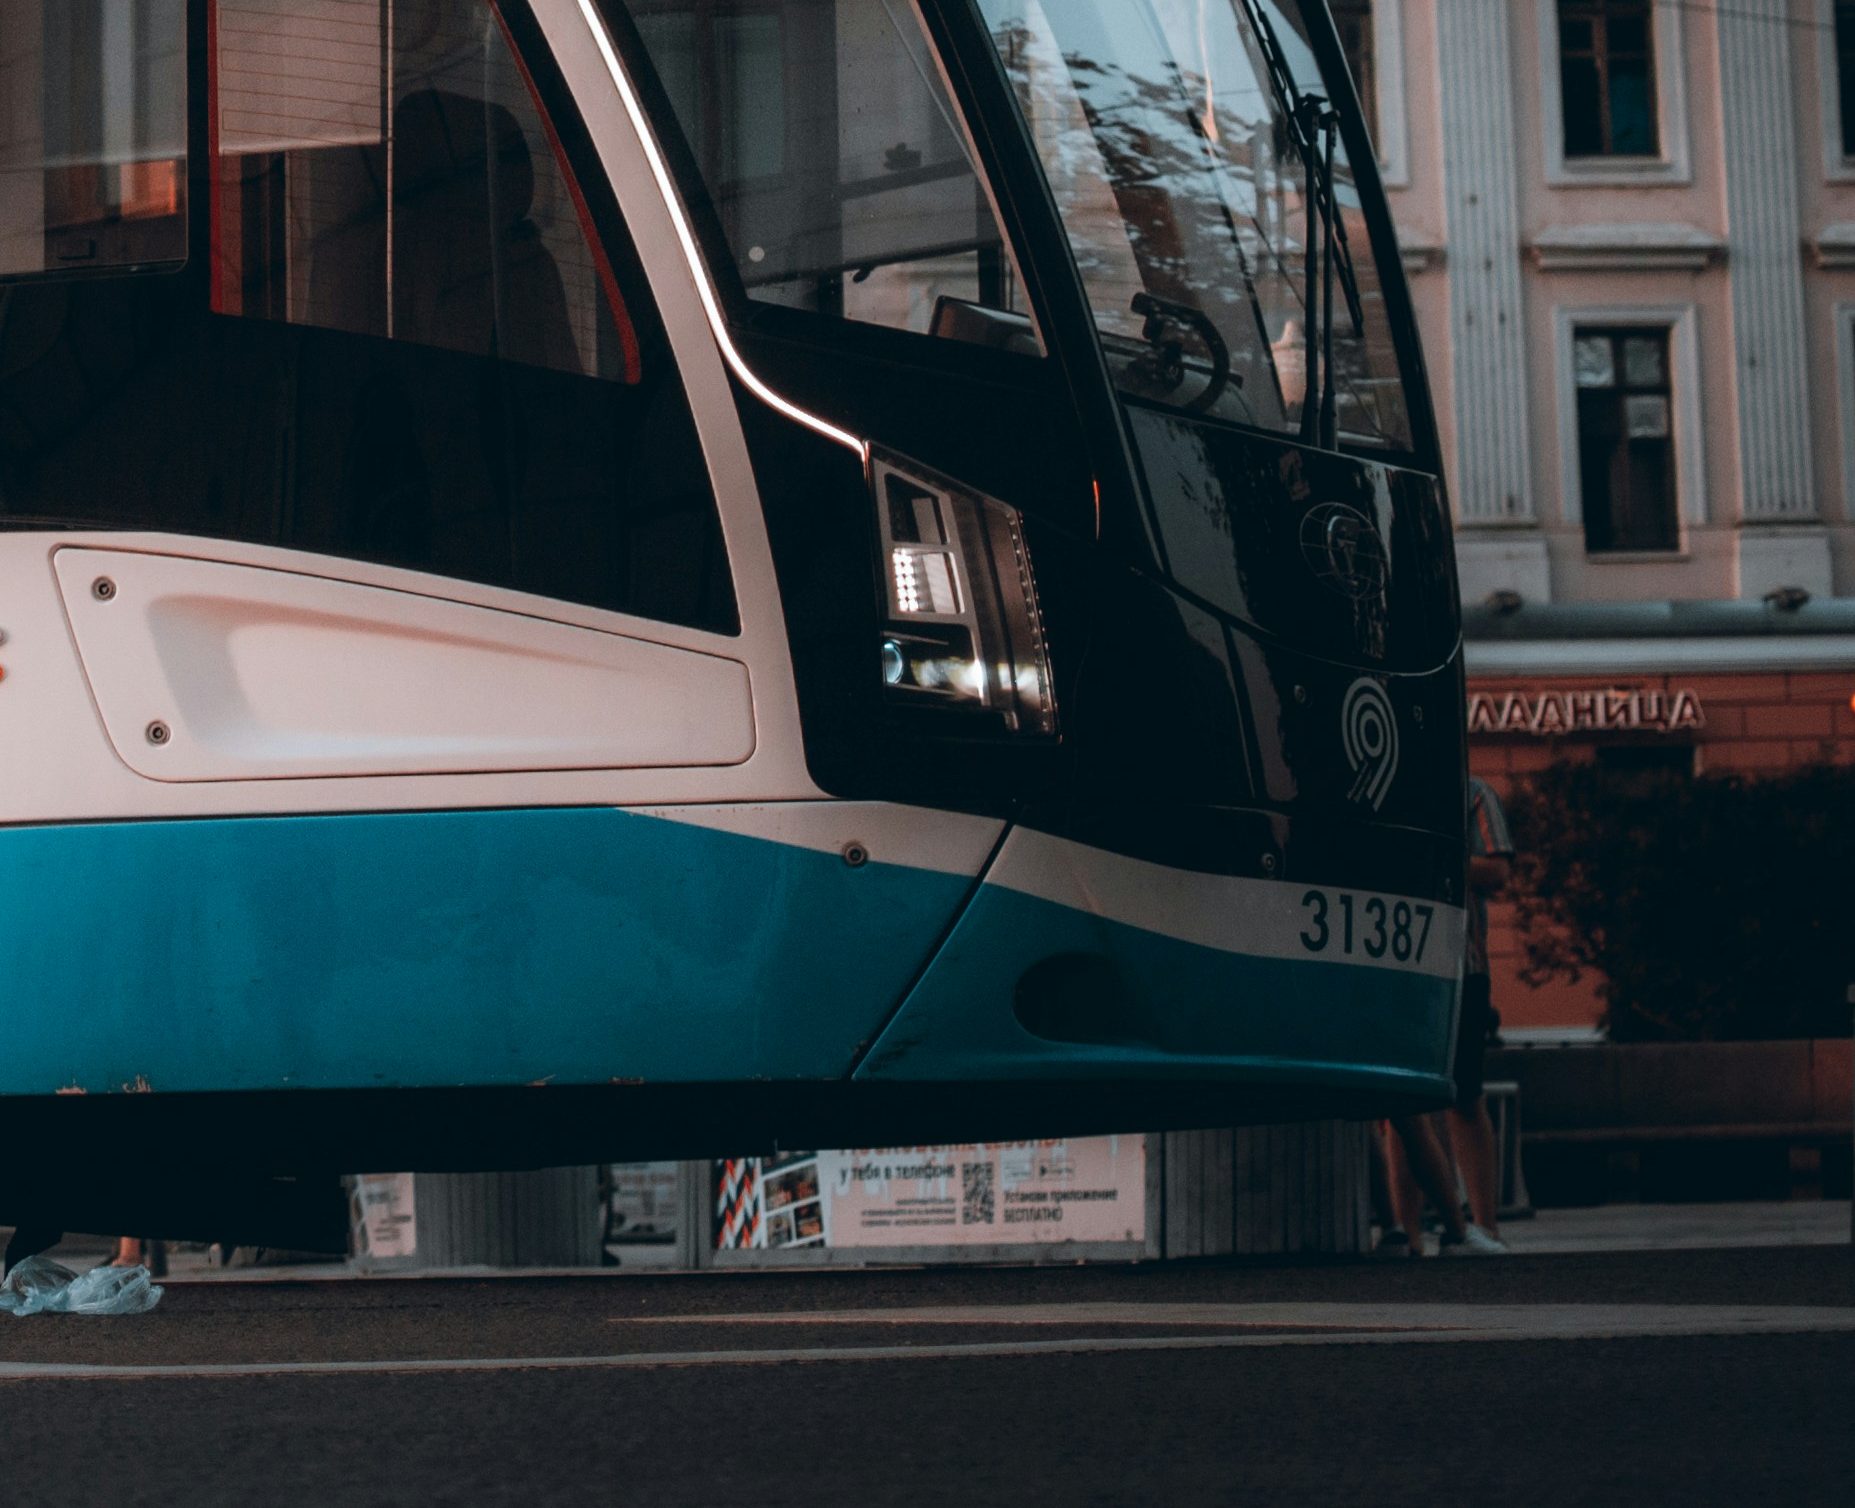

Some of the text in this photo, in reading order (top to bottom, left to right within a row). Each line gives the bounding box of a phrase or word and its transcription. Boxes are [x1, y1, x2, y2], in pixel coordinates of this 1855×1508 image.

[1468, 689, 1706, 734] ЛАДНИЦА
[1299, 890, 1434, 964] 31387
[852, 1162, 881, 1180] тебя
[884, 1167, 892, 1180] в
[895, 1161, 956, 1181] телефоне
[1050, 1189, 1118, 1205] приложение
[1003, 1206, 1063, 1223] БЕСПЛАТНО
